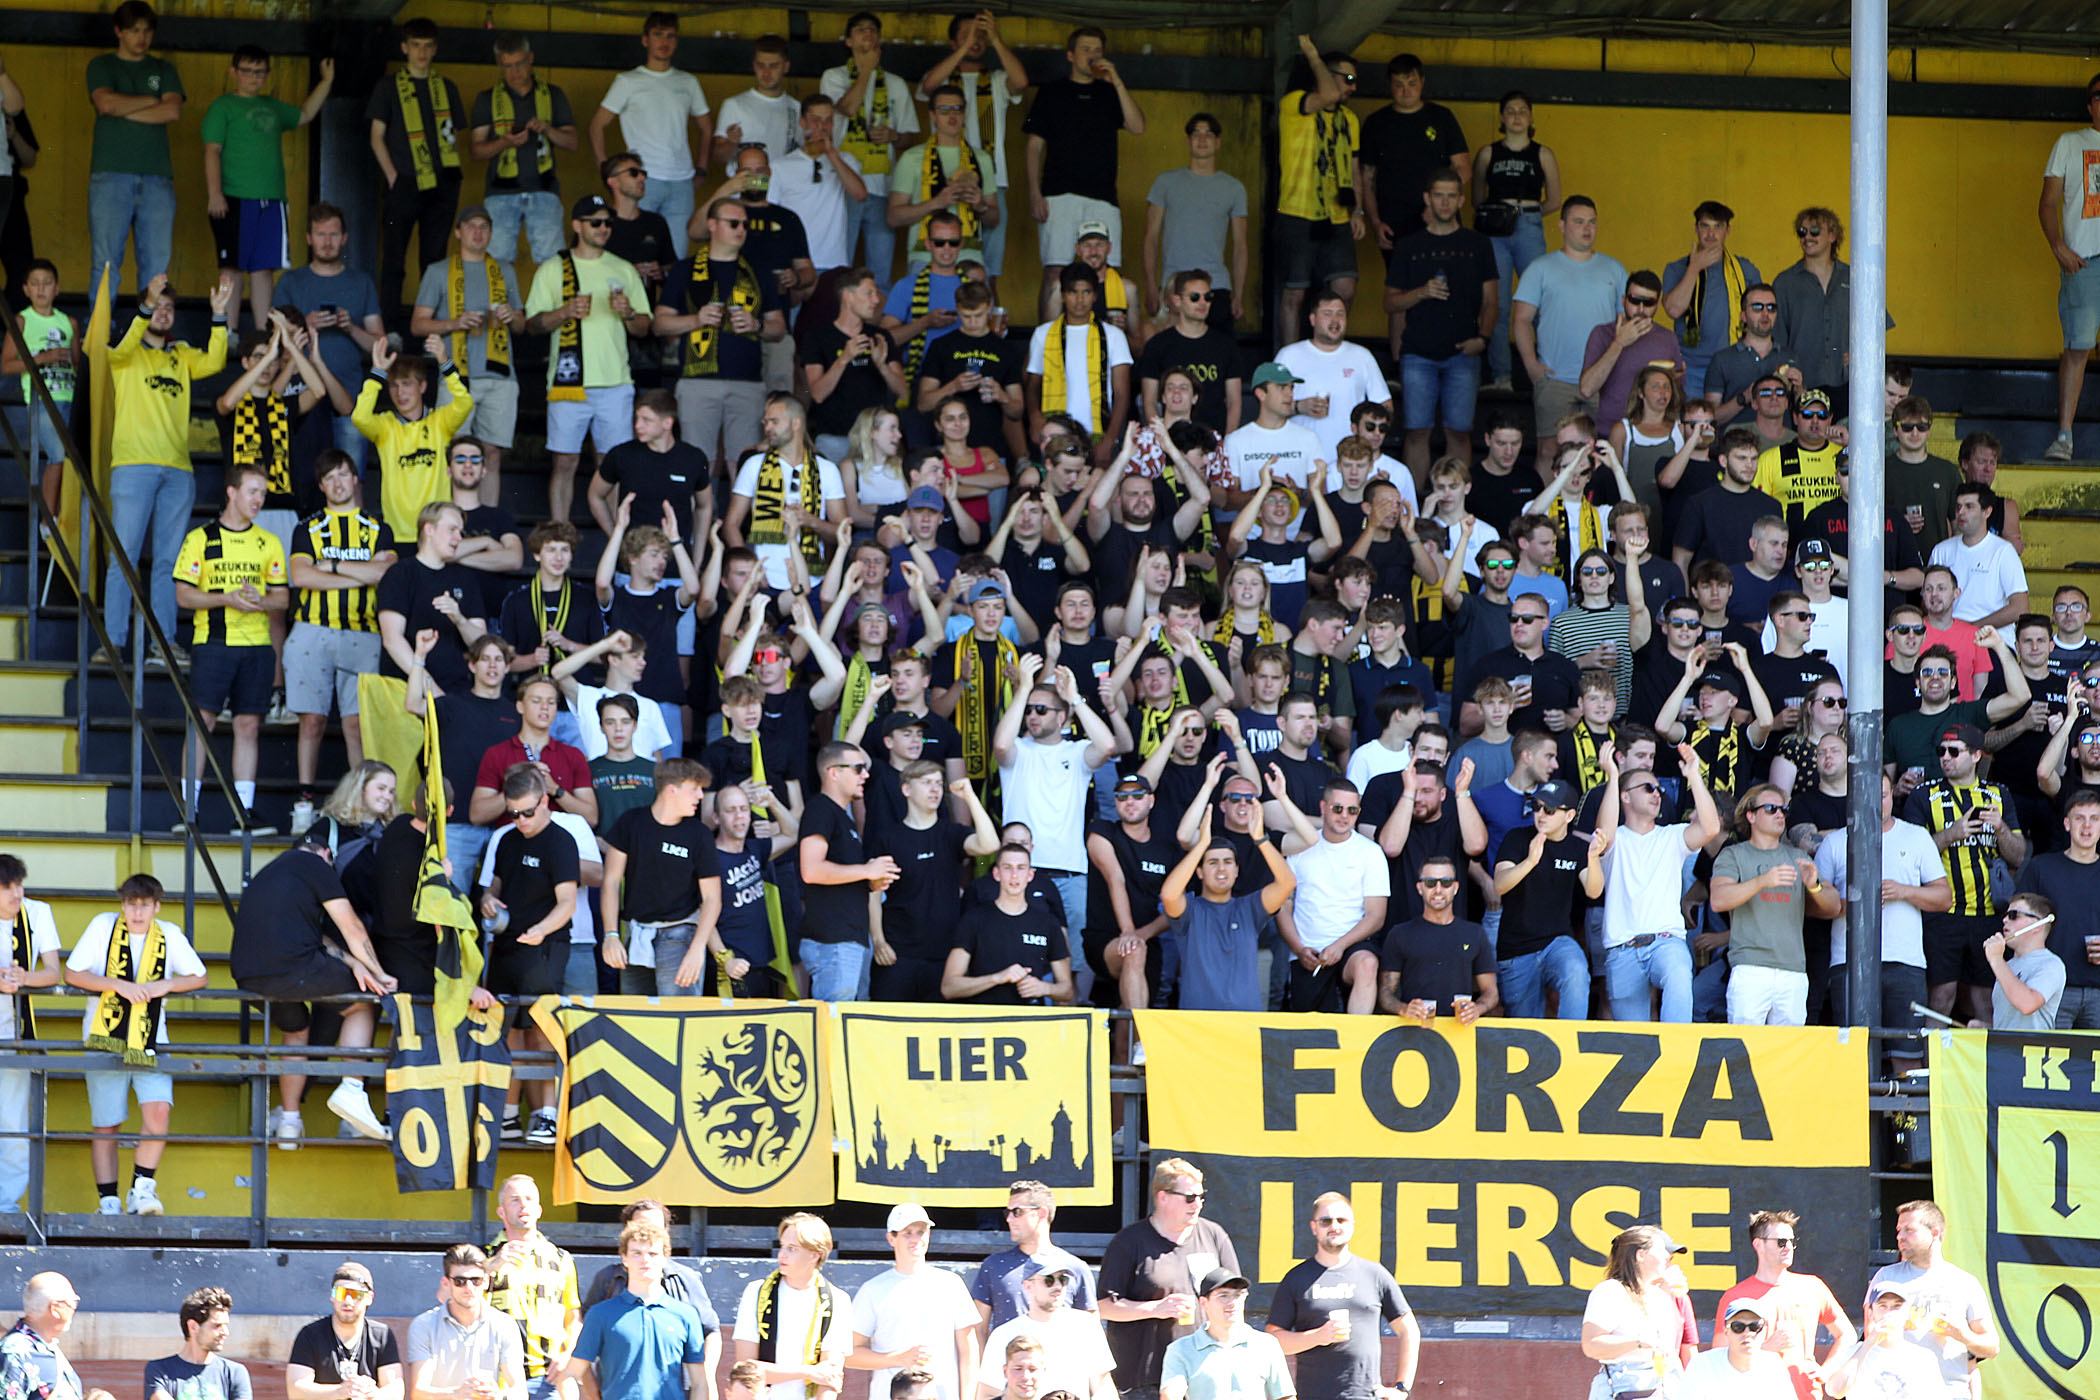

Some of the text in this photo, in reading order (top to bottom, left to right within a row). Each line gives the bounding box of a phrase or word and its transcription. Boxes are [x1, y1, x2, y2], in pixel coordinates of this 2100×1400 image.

[905, 1035, 1029, 1082] LIER
[1260, 1025, 1774, 1141] FORZA
[1258, 1180, 1738, 1292] LIERSE
